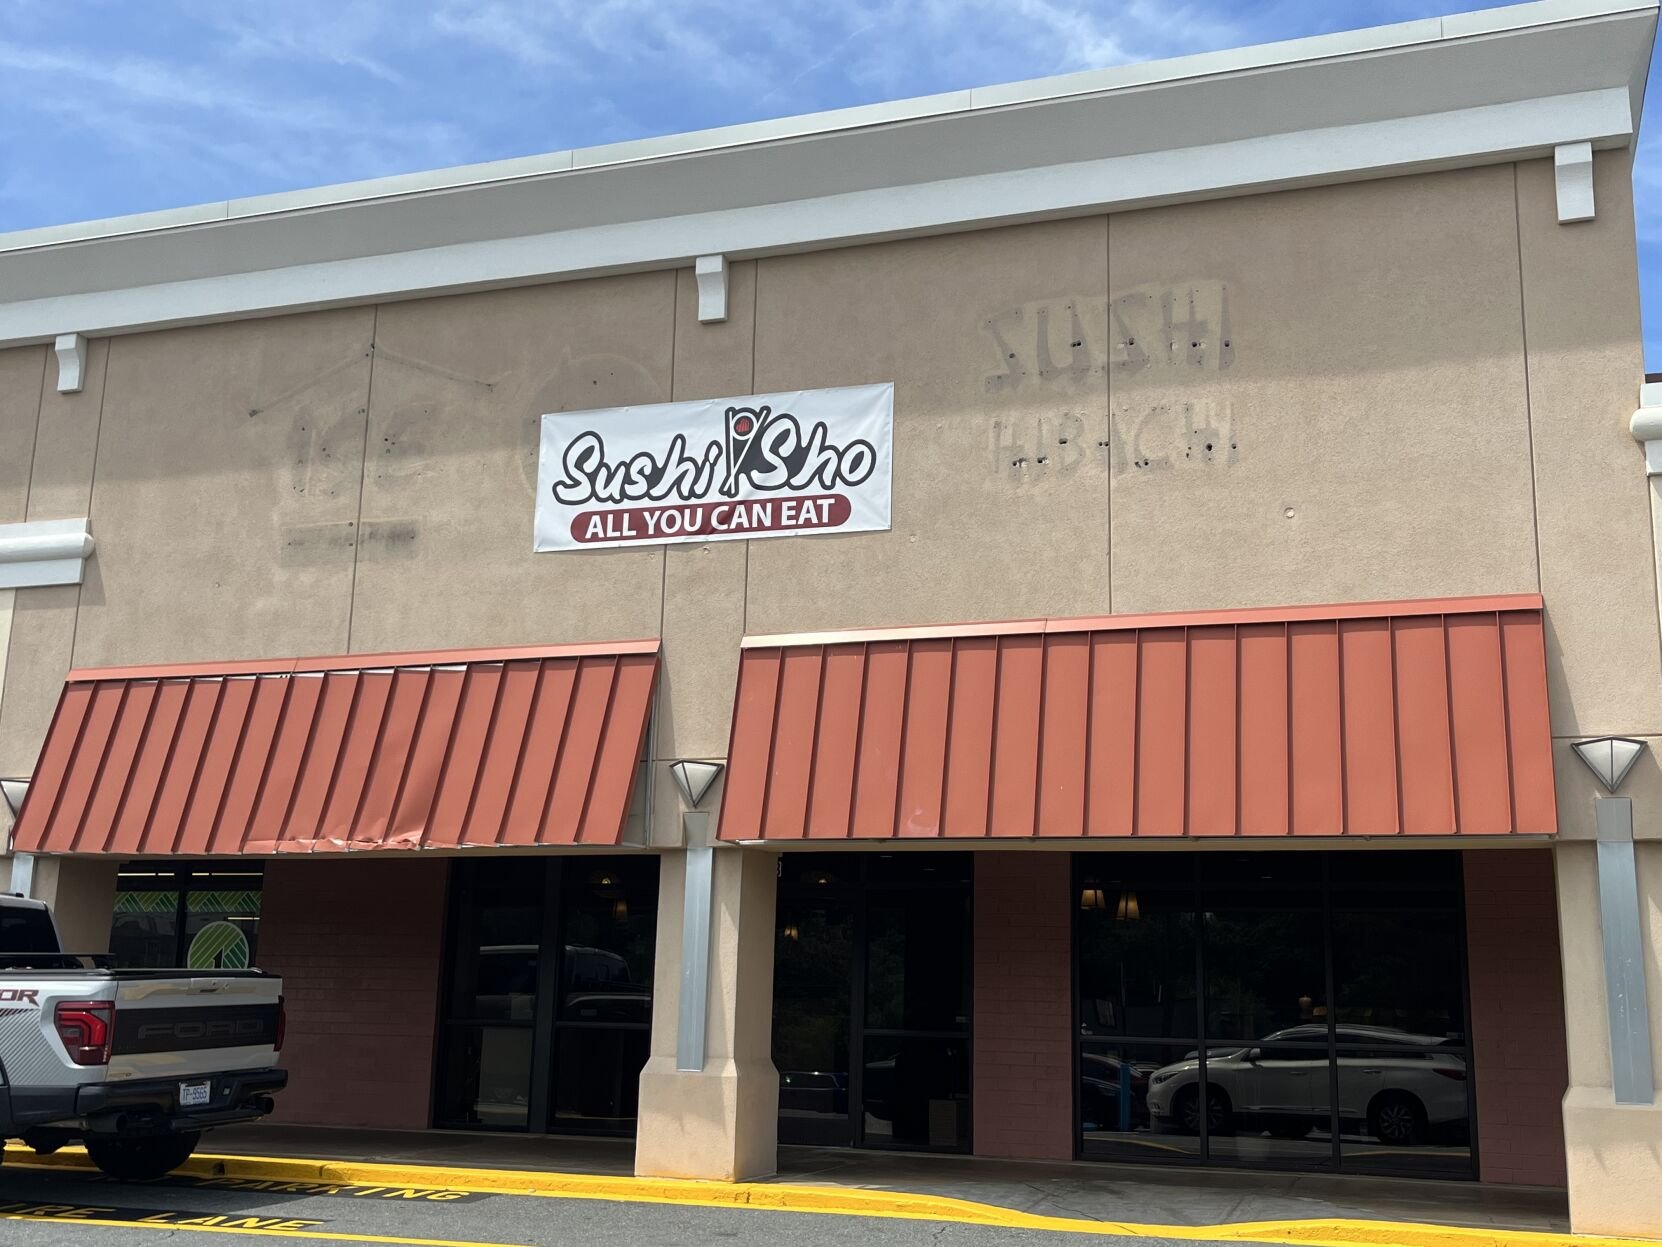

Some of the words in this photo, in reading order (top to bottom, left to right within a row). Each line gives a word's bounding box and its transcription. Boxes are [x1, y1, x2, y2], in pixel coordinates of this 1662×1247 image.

[552, 431, 723, 505] Sushi
[746, 413, 877, 491] Sho
[585, 512, 636, 539] ALL
[642, 507, 703, 534] YOU
[710, 503, 772, 531] CAN
[781, 498, 835, 525] EAT
[138, 1019, 263, 1040] FORD
[137, 1207, 325, 1231] LANE
